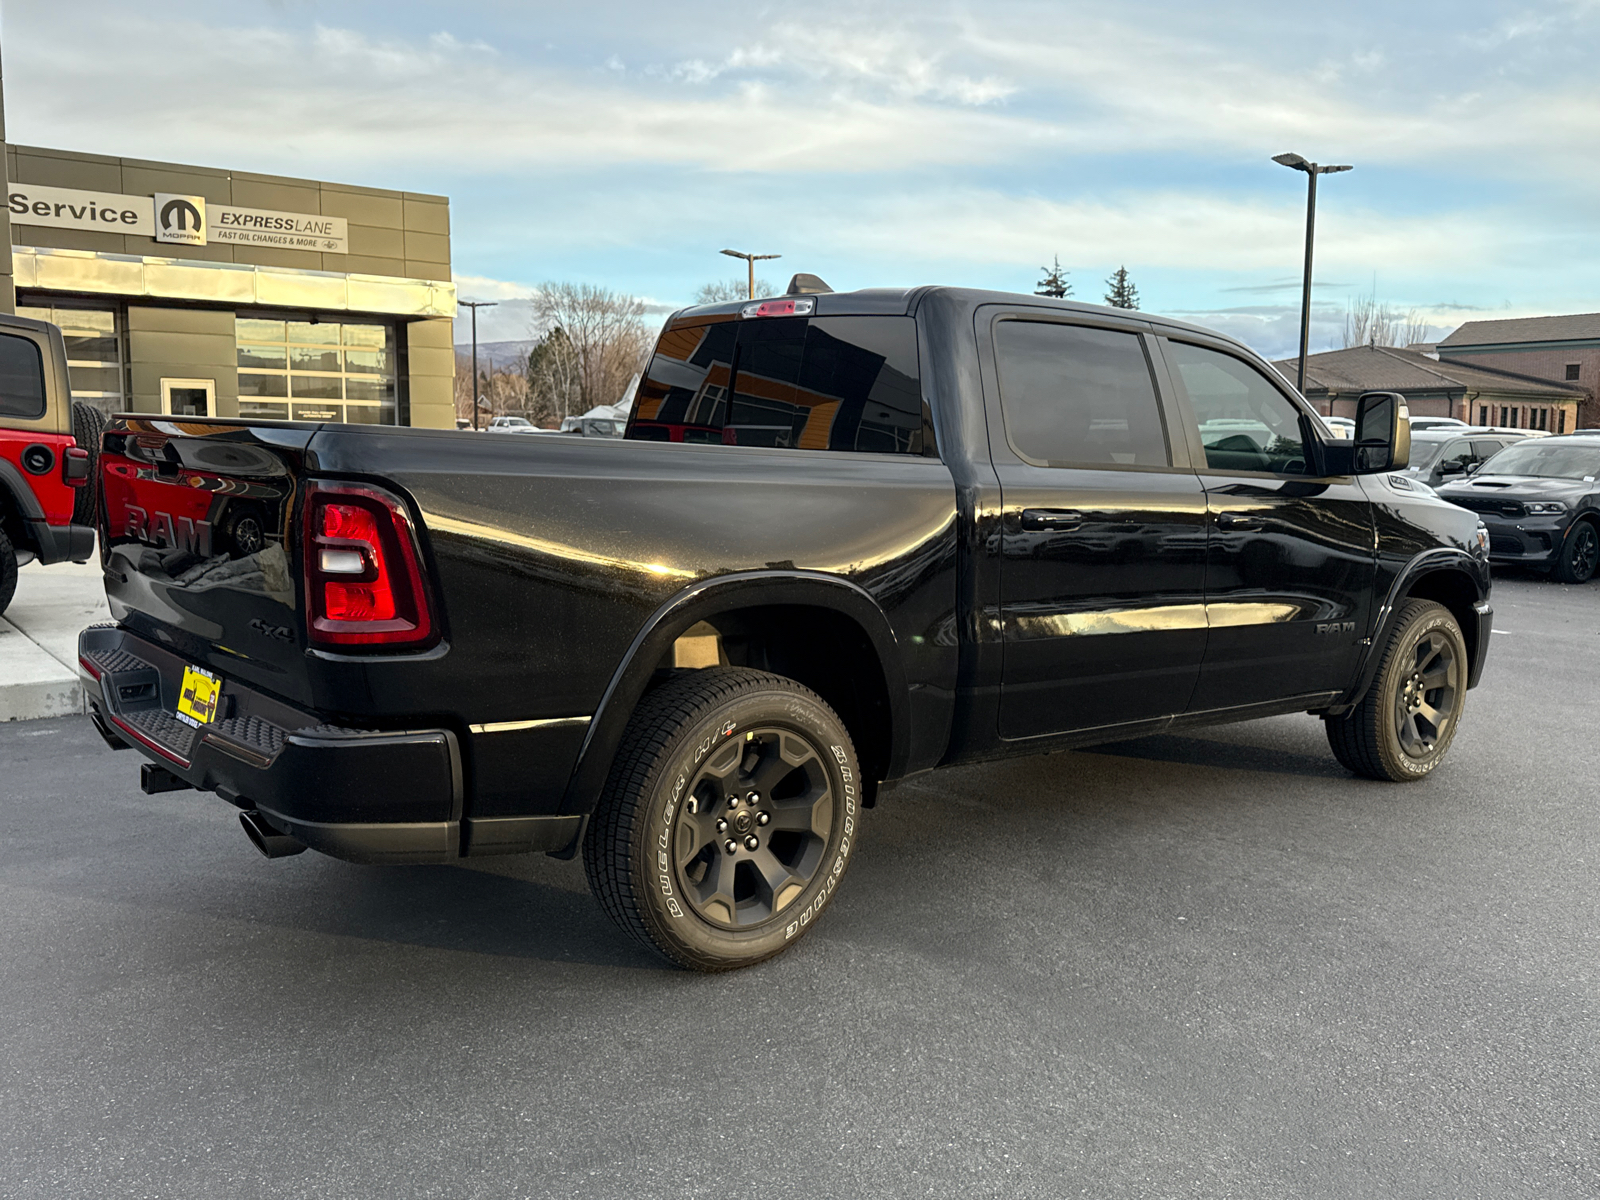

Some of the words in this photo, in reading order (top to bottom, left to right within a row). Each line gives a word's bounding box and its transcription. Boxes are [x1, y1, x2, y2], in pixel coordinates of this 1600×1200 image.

[8, 193, 139, 225] Service
[162, 232, 201, 241] MOPAR
[218, 230, 238, 240] FAST
[238, 232, 251, 242] OIL
[252, 234, 288, 245] CHANGES
[288, 236, 295, 246] &
[296, 238, 318, 248] MORE
[124, 503, 213, 559] RAM
[1315, 621, 1356, 634] RAM
[658, 773, 684, 918] DUELER
[694, 720, 737, 764] H/L
[784, 744, 856, 940] BRIDGESTONE
